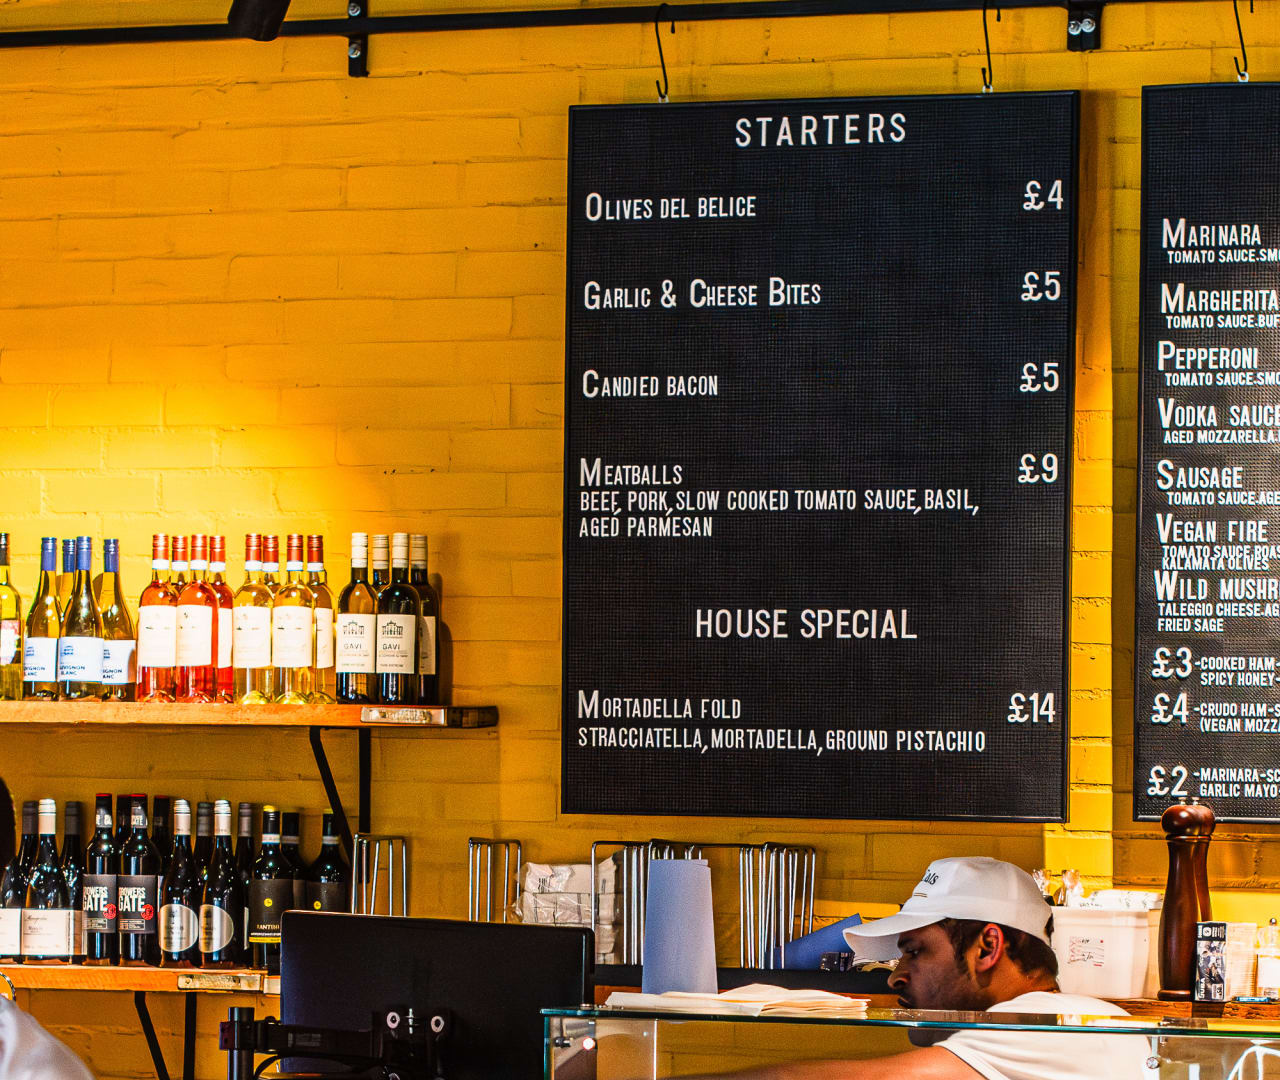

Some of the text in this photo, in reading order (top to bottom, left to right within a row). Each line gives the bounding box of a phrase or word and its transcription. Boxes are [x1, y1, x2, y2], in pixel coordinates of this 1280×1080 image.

[735, 113, 906, 147] STARTERS
[586, 179, 1064, 221] OLIVES DEL BELICE £4
[1162, 218, 1261, 248] MARINARA
[1168, 250, 1215, 264] TOMATO
[584, 271, 1061, 310] GARLIC & CHEESE BITES £5
[1161, 283, 1279, 313] MARGHERITA
[1166, 315, 1213, 328] TOMATO
[1158, 340, 1258, 370] PEPPERONI
[582, 362, 1059, 398] CANDIED BACON £5
[1165, 373, 1212, 386] TOMATO
[1158, 398, 1217, 428] VODKA
[1164, 431, 1193, 444] AGED
[580, 453, 1058, 487] MEATBALLS £9
[1157, 459, 1243, 490] SAUSAGE
[727, 490, 789, 511] COOKED
[794, 489, 856, 511] TOMATO
[1167, 492, 1213, 505] TOMATO
[579, 516, 713, 538] AGED PARMESAN
[1156, 514, 1217, 543] VEGAN
[1228, 521, 1268, 542] FIRE
[1162, 545, 1210, 559] TOMATO
[1162, 557, 1269, 571] KALAMATA OLIVES
[1154, 570, 1208, 601] WILD
[696, 608, 918, 639] HOUSE SPECIAL
[1158, 603, 1212, 617] TALEGGIO
[1158, 619, 1224, 632] FRIED SAGE
[1152, 647, 1192, 679] £3
[1201, 673, 1234, 687] SPICY
[578, 689, 1056, 723] MORTADELLA FOLD £14
[1152, 693, 1189, 724] £4
[1200, 719, 1240, 733] (VEGAN
[896, 730, 986, 753] PISTACHIO
[1148, 766, 1188, 797] £2
[1200, 784, 1240, 797] GARLIC
